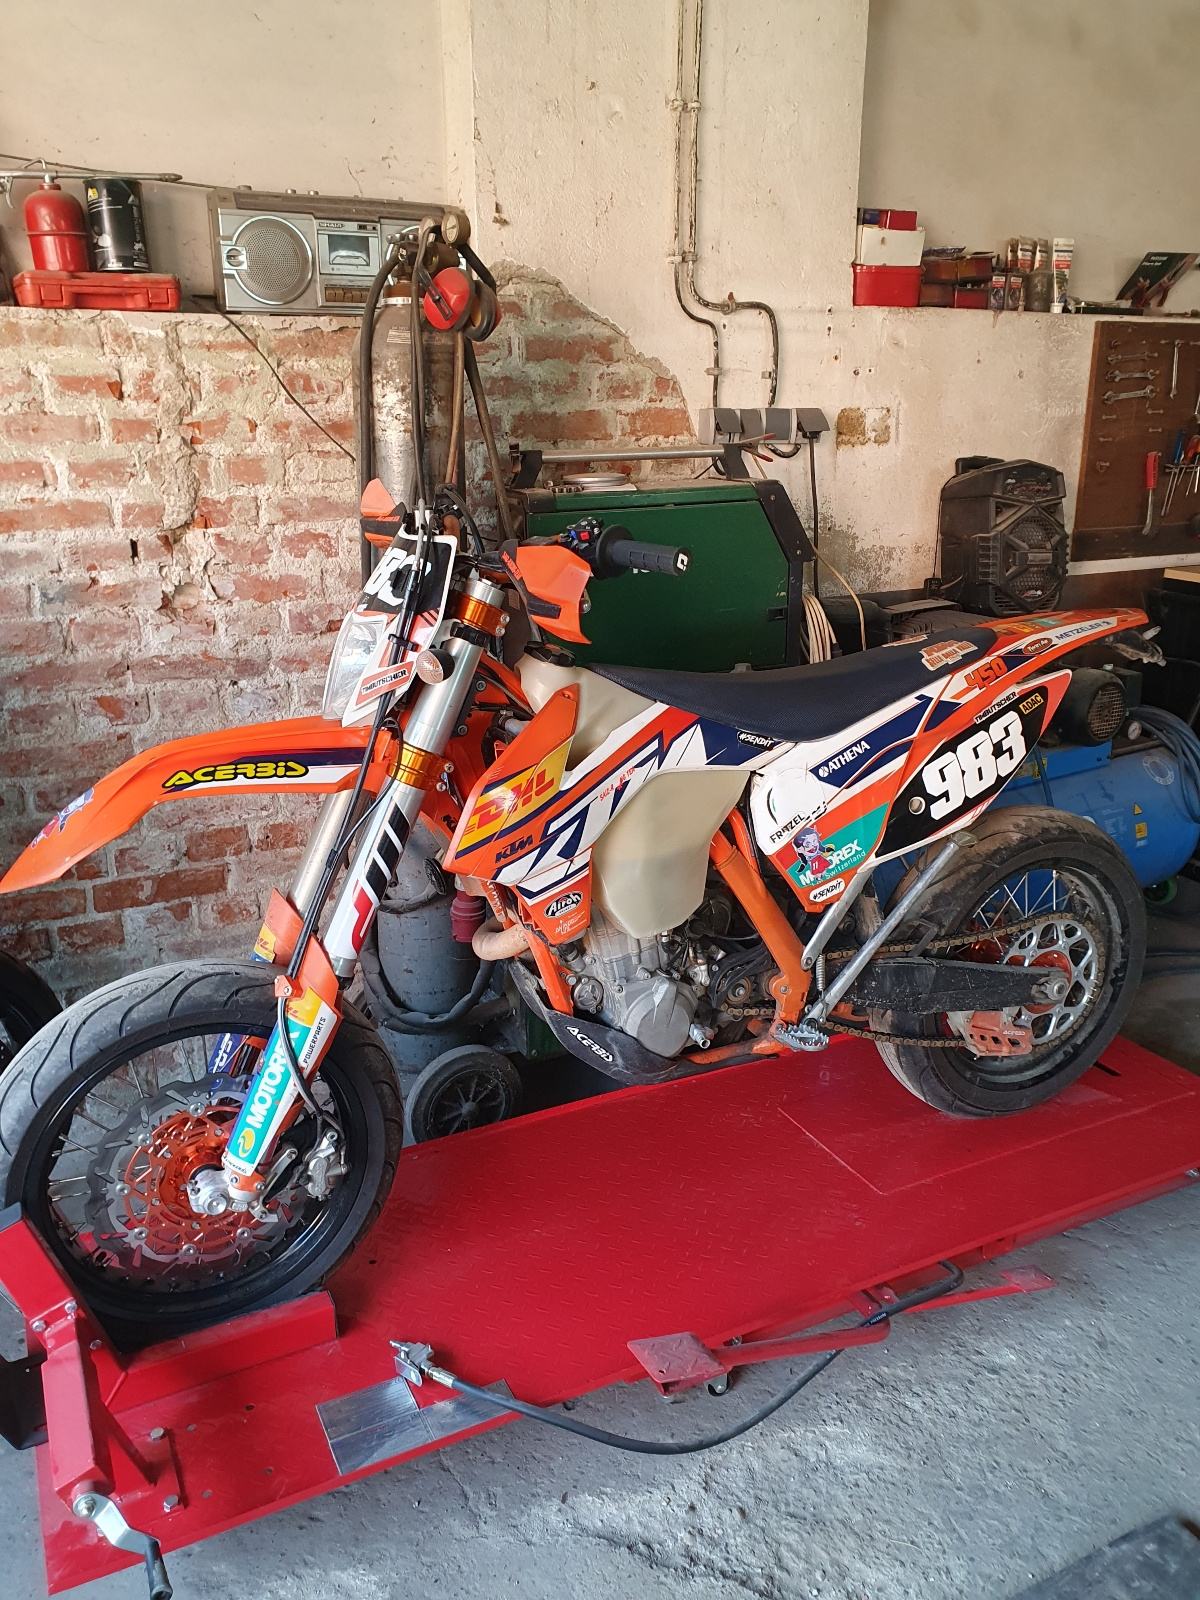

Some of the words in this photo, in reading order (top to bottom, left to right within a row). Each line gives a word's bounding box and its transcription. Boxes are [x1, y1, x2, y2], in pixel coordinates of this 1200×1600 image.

[964, 657, 1008, 691] 450
[1022, 694, 1042, 713] ADAC
[164, 761, 306, 787] ACERBIS
[829, 740, 871, 776] ATHENA
[922, 711, 1027, 820] 983
[472, 768, 556, 831] DHL
[495, 834, 534, 864] KTM
[798, 839, 863, 887] MOREX
[824, 850, 866, 881] Switzerland
[547, 893, 582, 917] Airoh
